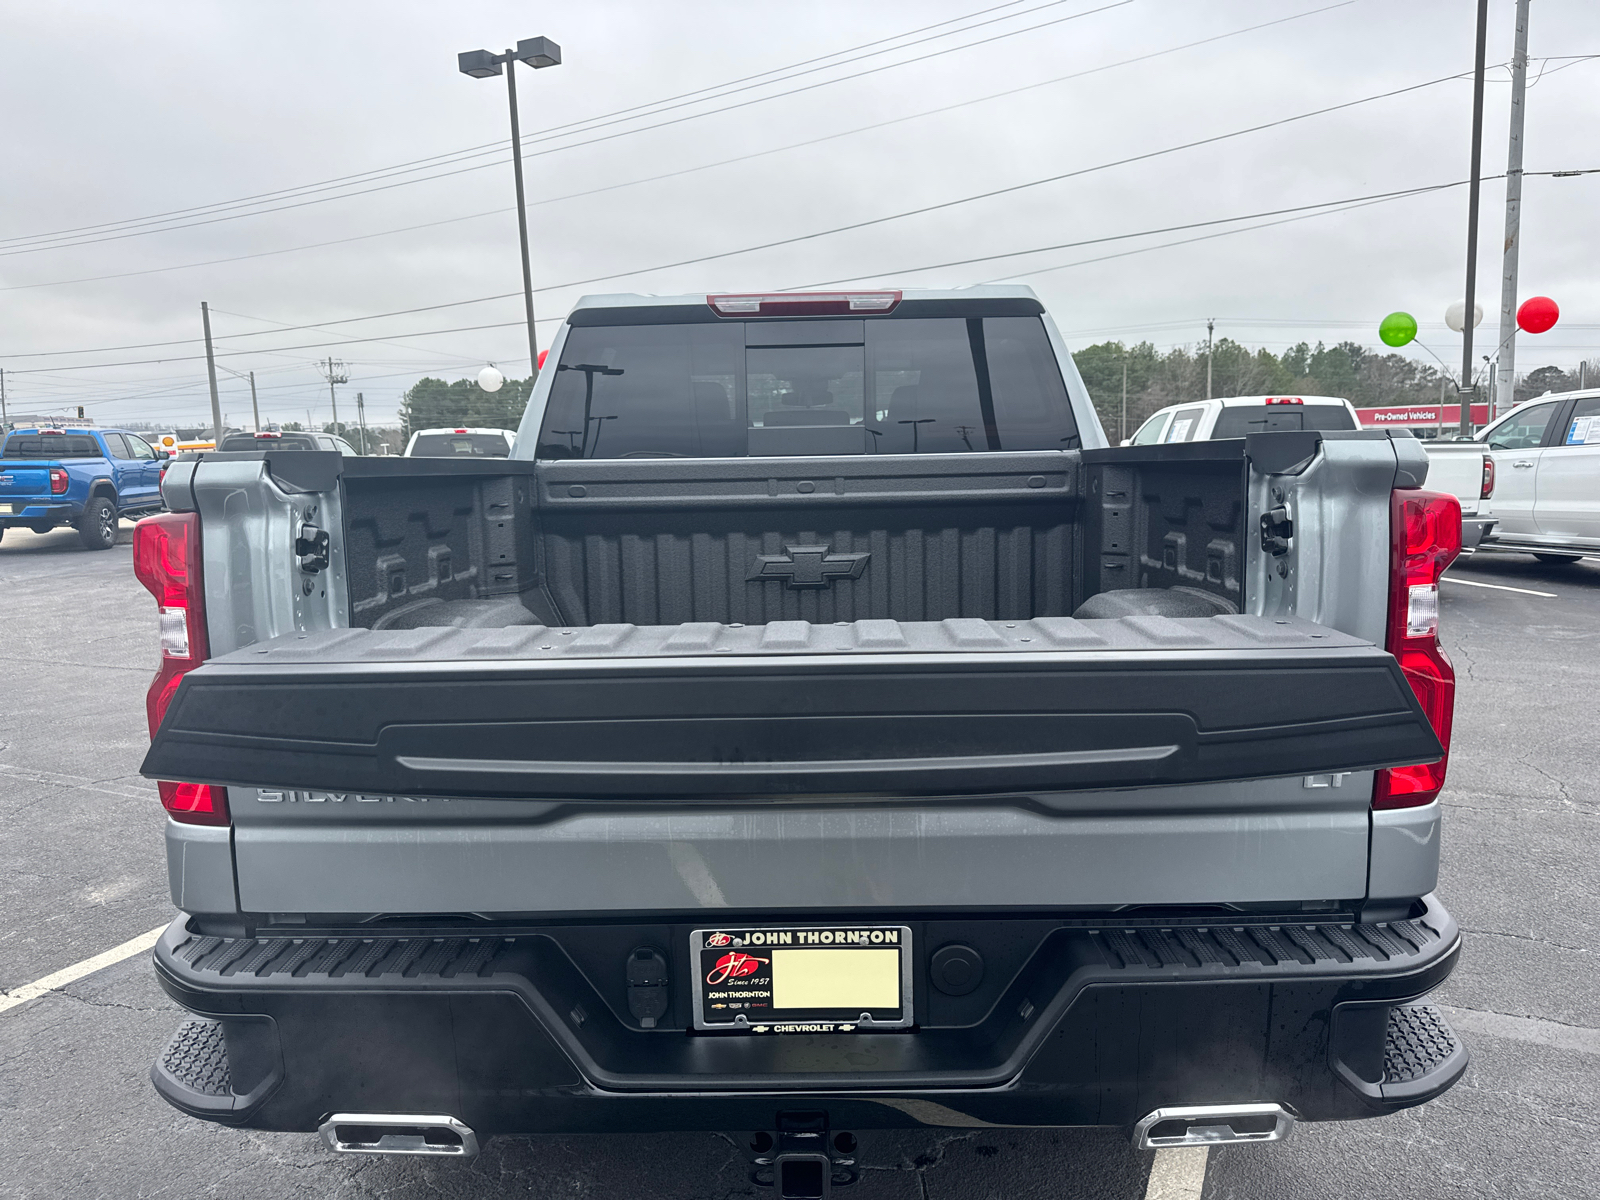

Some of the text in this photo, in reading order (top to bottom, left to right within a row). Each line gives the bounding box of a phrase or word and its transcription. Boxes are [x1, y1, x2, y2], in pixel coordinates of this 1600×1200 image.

[1374, 411, 1436, 421] Pre-Owned Vehicles
[1303, 771, 1351, 788] LT
[742, 932, 792, 945] JOHN
[727, 977, 770, 986] Since 1957
[708, 990, 770, 999] JOHN THORNTON
[773, 1024, 835, 1033] CHEVROLET
